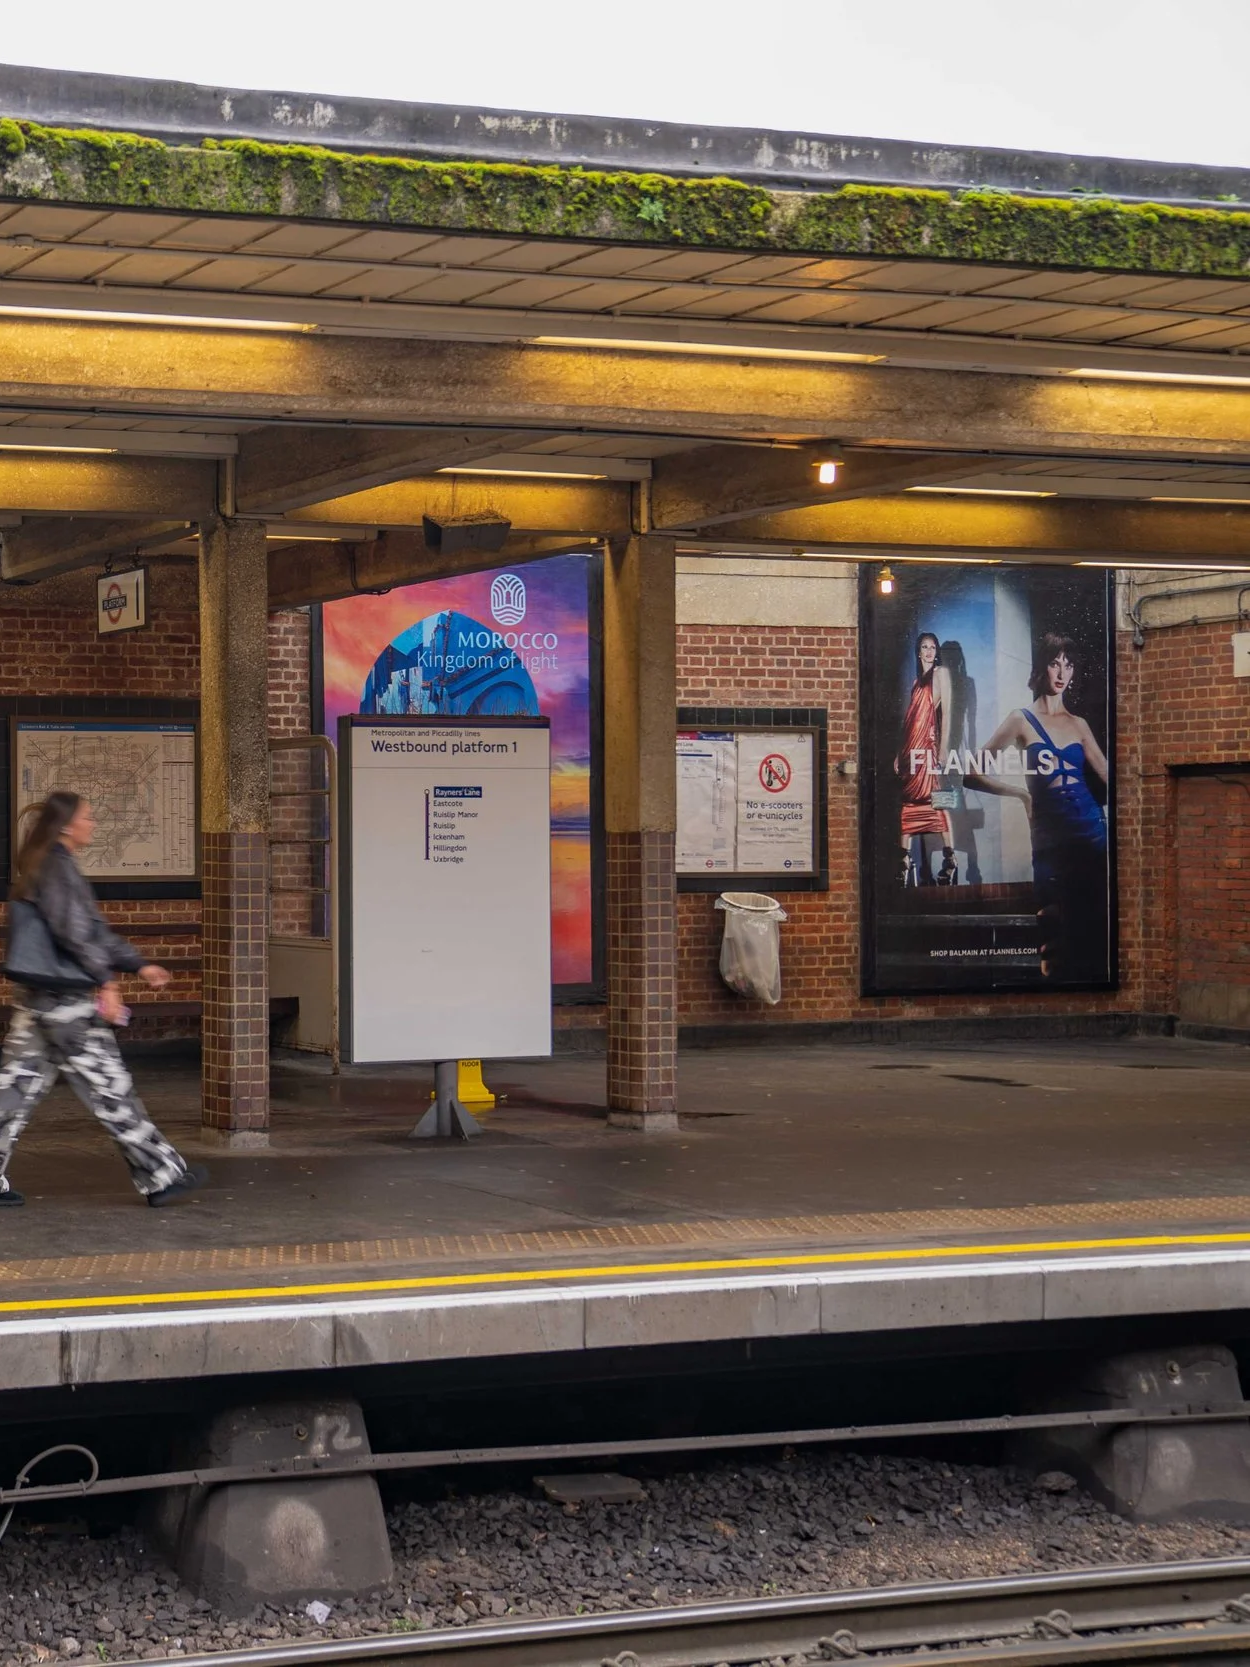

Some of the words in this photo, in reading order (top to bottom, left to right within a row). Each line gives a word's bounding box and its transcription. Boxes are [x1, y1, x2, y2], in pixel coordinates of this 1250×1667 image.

[458, 631, 558, 650] MOROCCO
[417, 650, 493, 673] Kingdom
[499, 651, 518, 670] of
[520, 652, 558, 674] light
[432, 730, 463, 738] Piccadilly
[371, 740, 447, 752] Westbound
[452, 741, 508, 755] platform
[512, 742, 517, 752] 1
[910, 748, 1055, 776] FLANNELS
[464, 788, 480, 796] Lane
[747, 801, 758, 809] No
[758, 812, 803, 821] e-unicycles
[433, 856, 464, 864] Uxbridge
